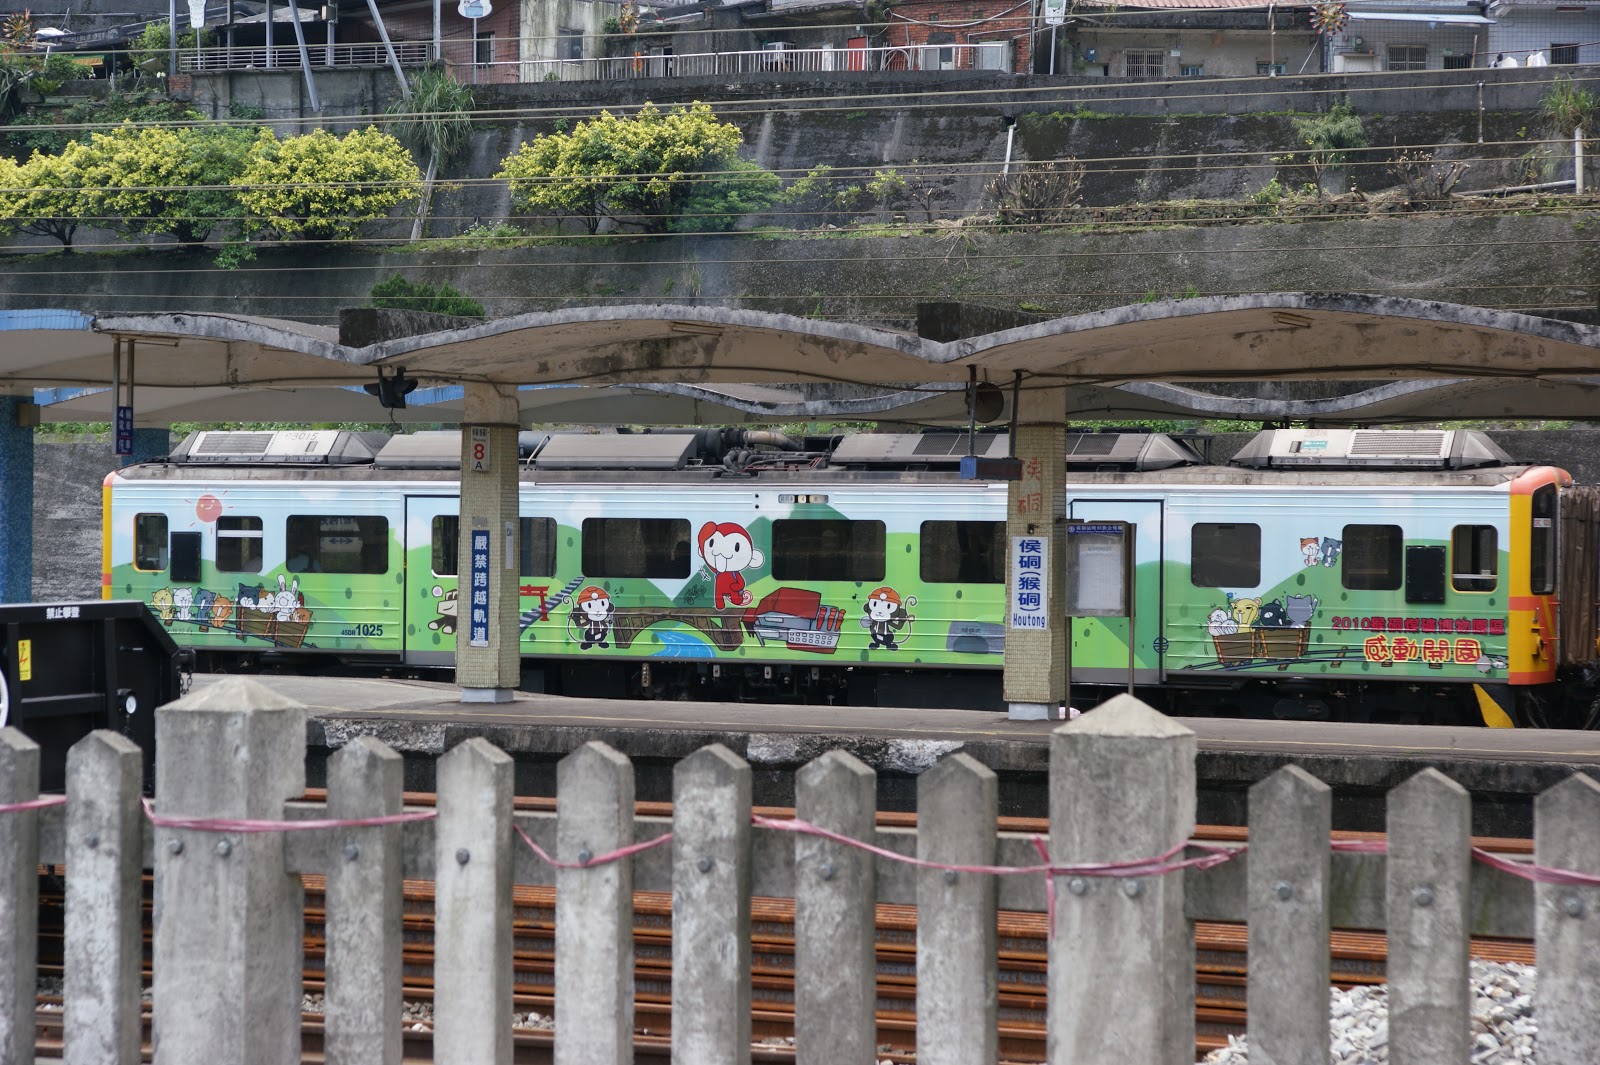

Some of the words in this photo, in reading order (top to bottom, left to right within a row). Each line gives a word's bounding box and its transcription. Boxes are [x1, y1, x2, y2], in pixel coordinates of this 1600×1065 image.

[473, 443, 485, 460] 8
[475, 461, 483, 470] A
[473, 535, 488, 642] 嚴禁跨越軌道
[46, 606, 80, 620] 禁止攀登
[1013, 613, 1046, 628] Houtong
[1363, 634, 1482, 665] 感動開園
